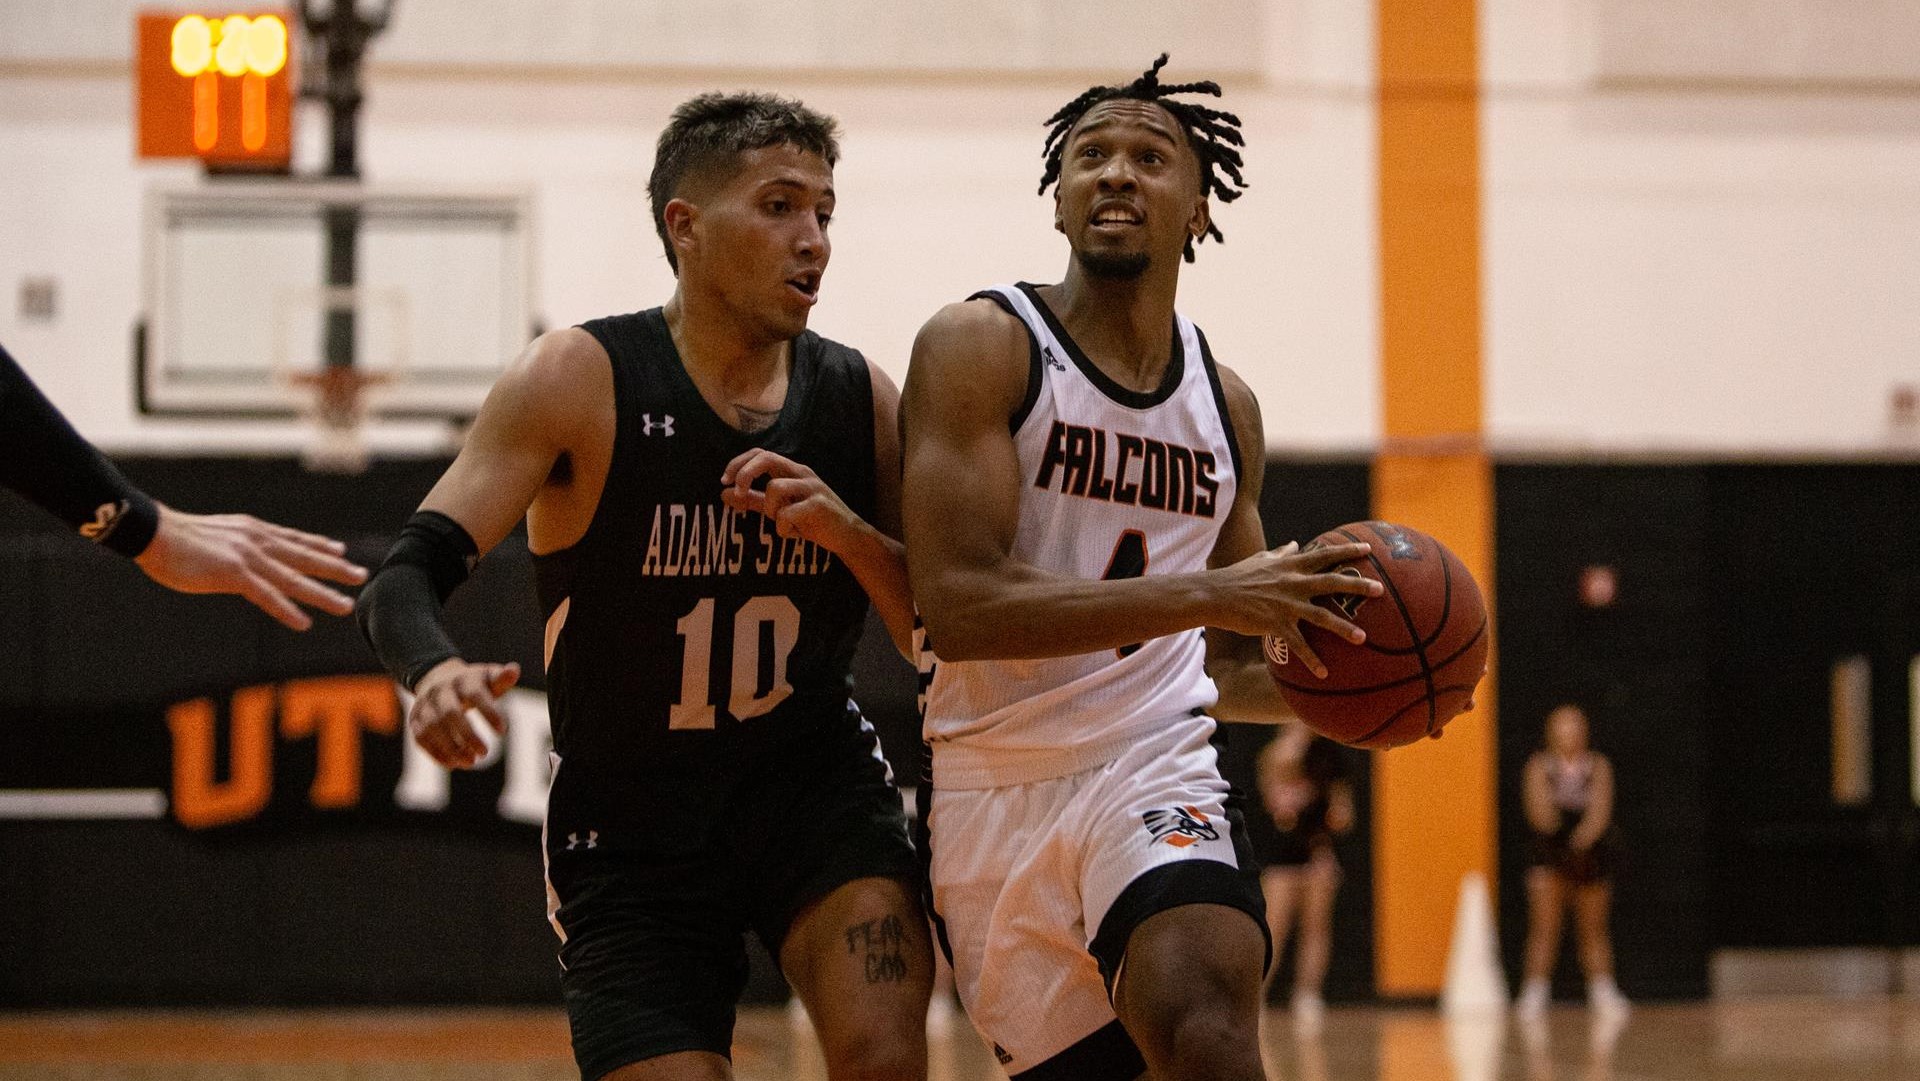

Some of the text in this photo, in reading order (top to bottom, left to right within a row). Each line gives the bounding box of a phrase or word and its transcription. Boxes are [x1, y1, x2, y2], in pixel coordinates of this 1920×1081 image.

[1034, 419, 1219, 519] FALCONS
[642, 503, 745, 576] ADAMS
[668, 596, 801, 729] 10
